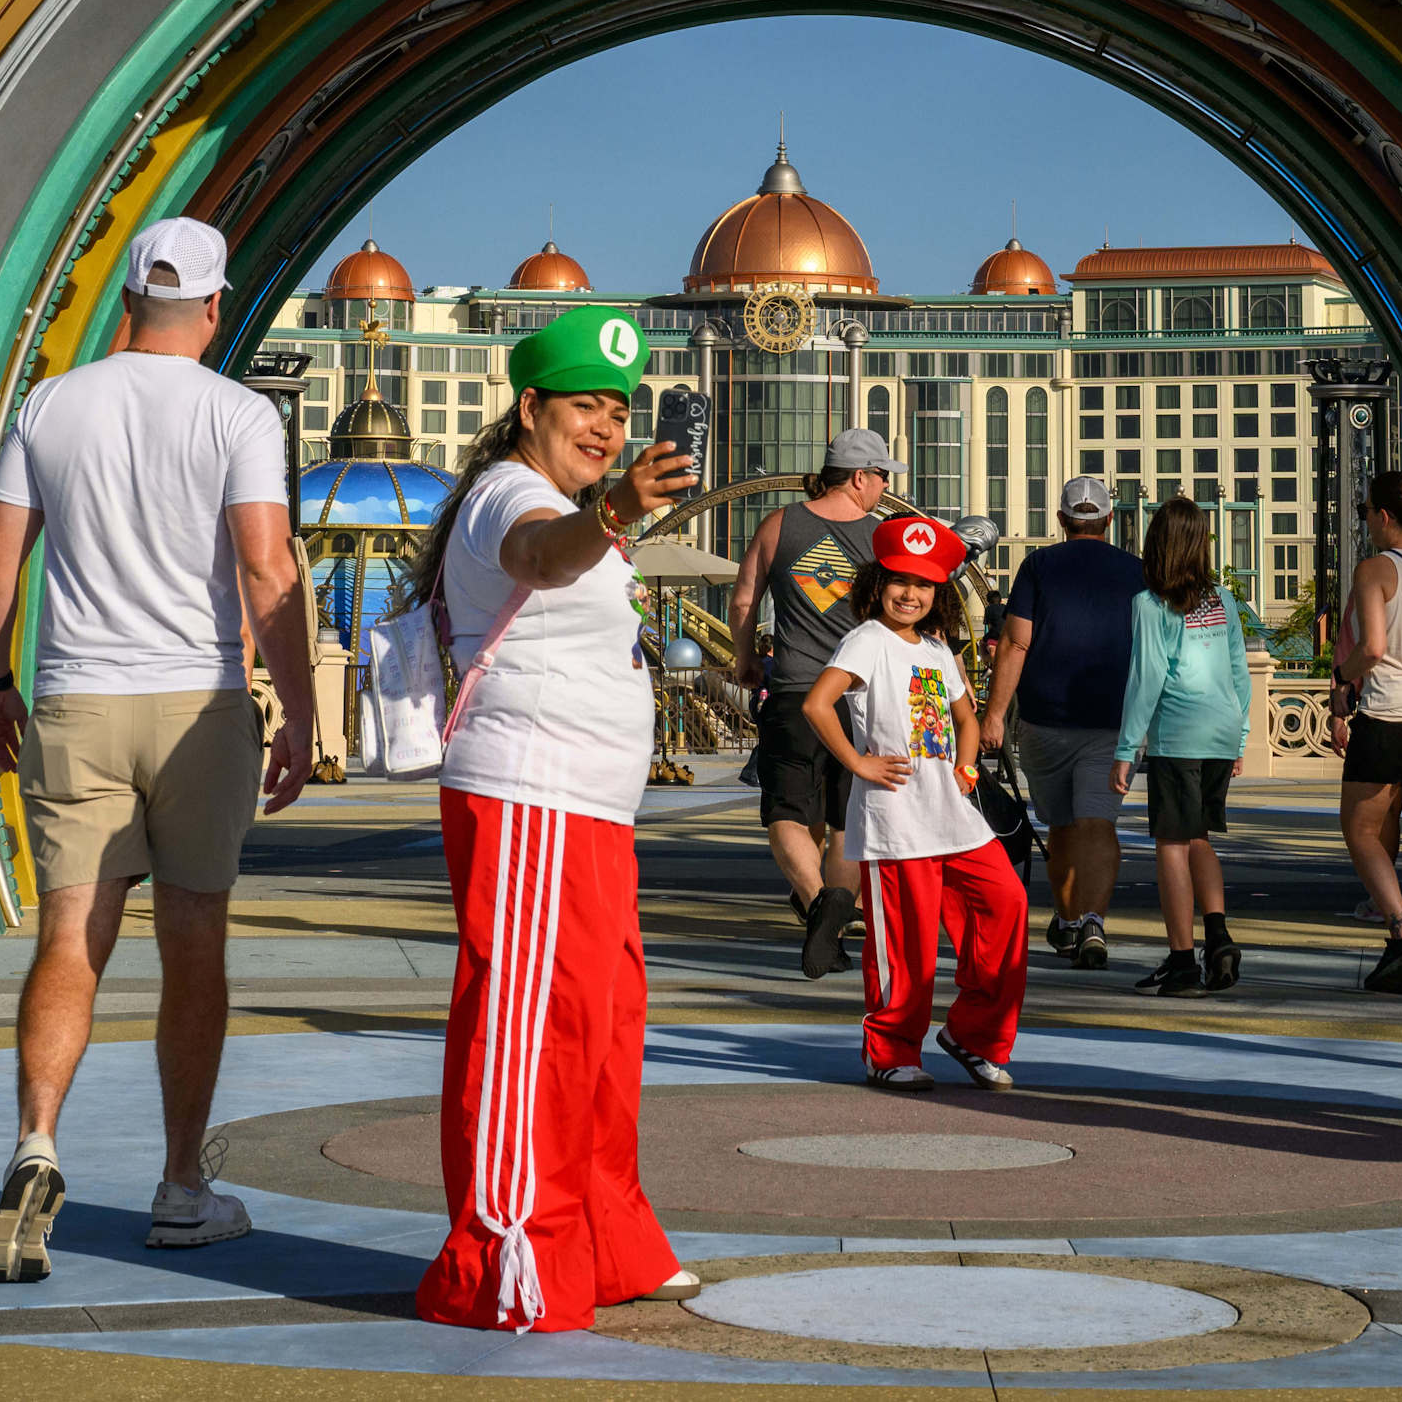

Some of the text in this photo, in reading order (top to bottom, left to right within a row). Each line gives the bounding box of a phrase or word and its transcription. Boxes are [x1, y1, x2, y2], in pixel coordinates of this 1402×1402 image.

[610, 326, 627, 360] L
[905, 527, 933, 547] M
[911, 664, 943, 682] SUPER
[909, 676, 948, 699] MARIO
